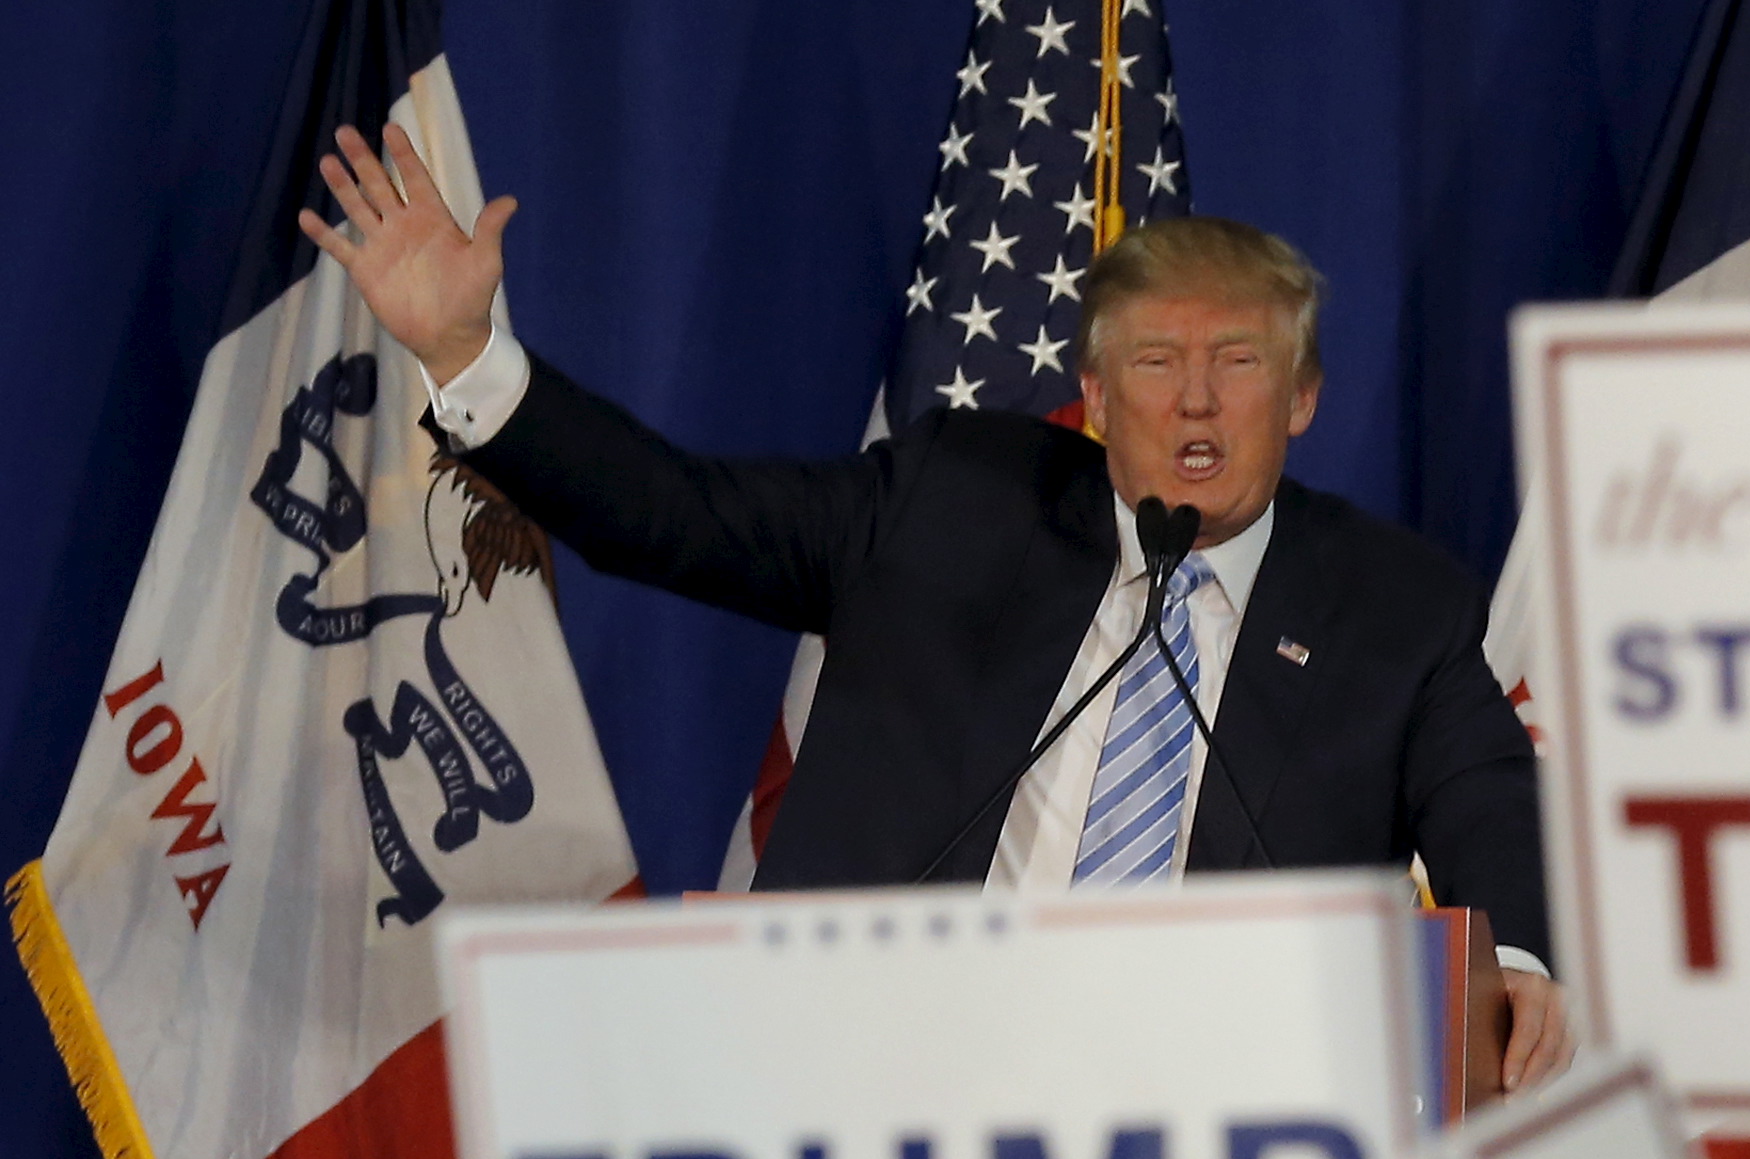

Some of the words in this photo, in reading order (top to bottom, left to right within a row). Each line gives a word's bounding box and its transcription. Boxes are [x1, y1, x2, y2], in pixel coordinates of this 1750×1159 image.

[408, 704, 445, 748] WE
[437, 750, 471, 822] WILL
[444, 680, 518, 785] RIGHTS
[103, 656, 232, 934] IOWA
